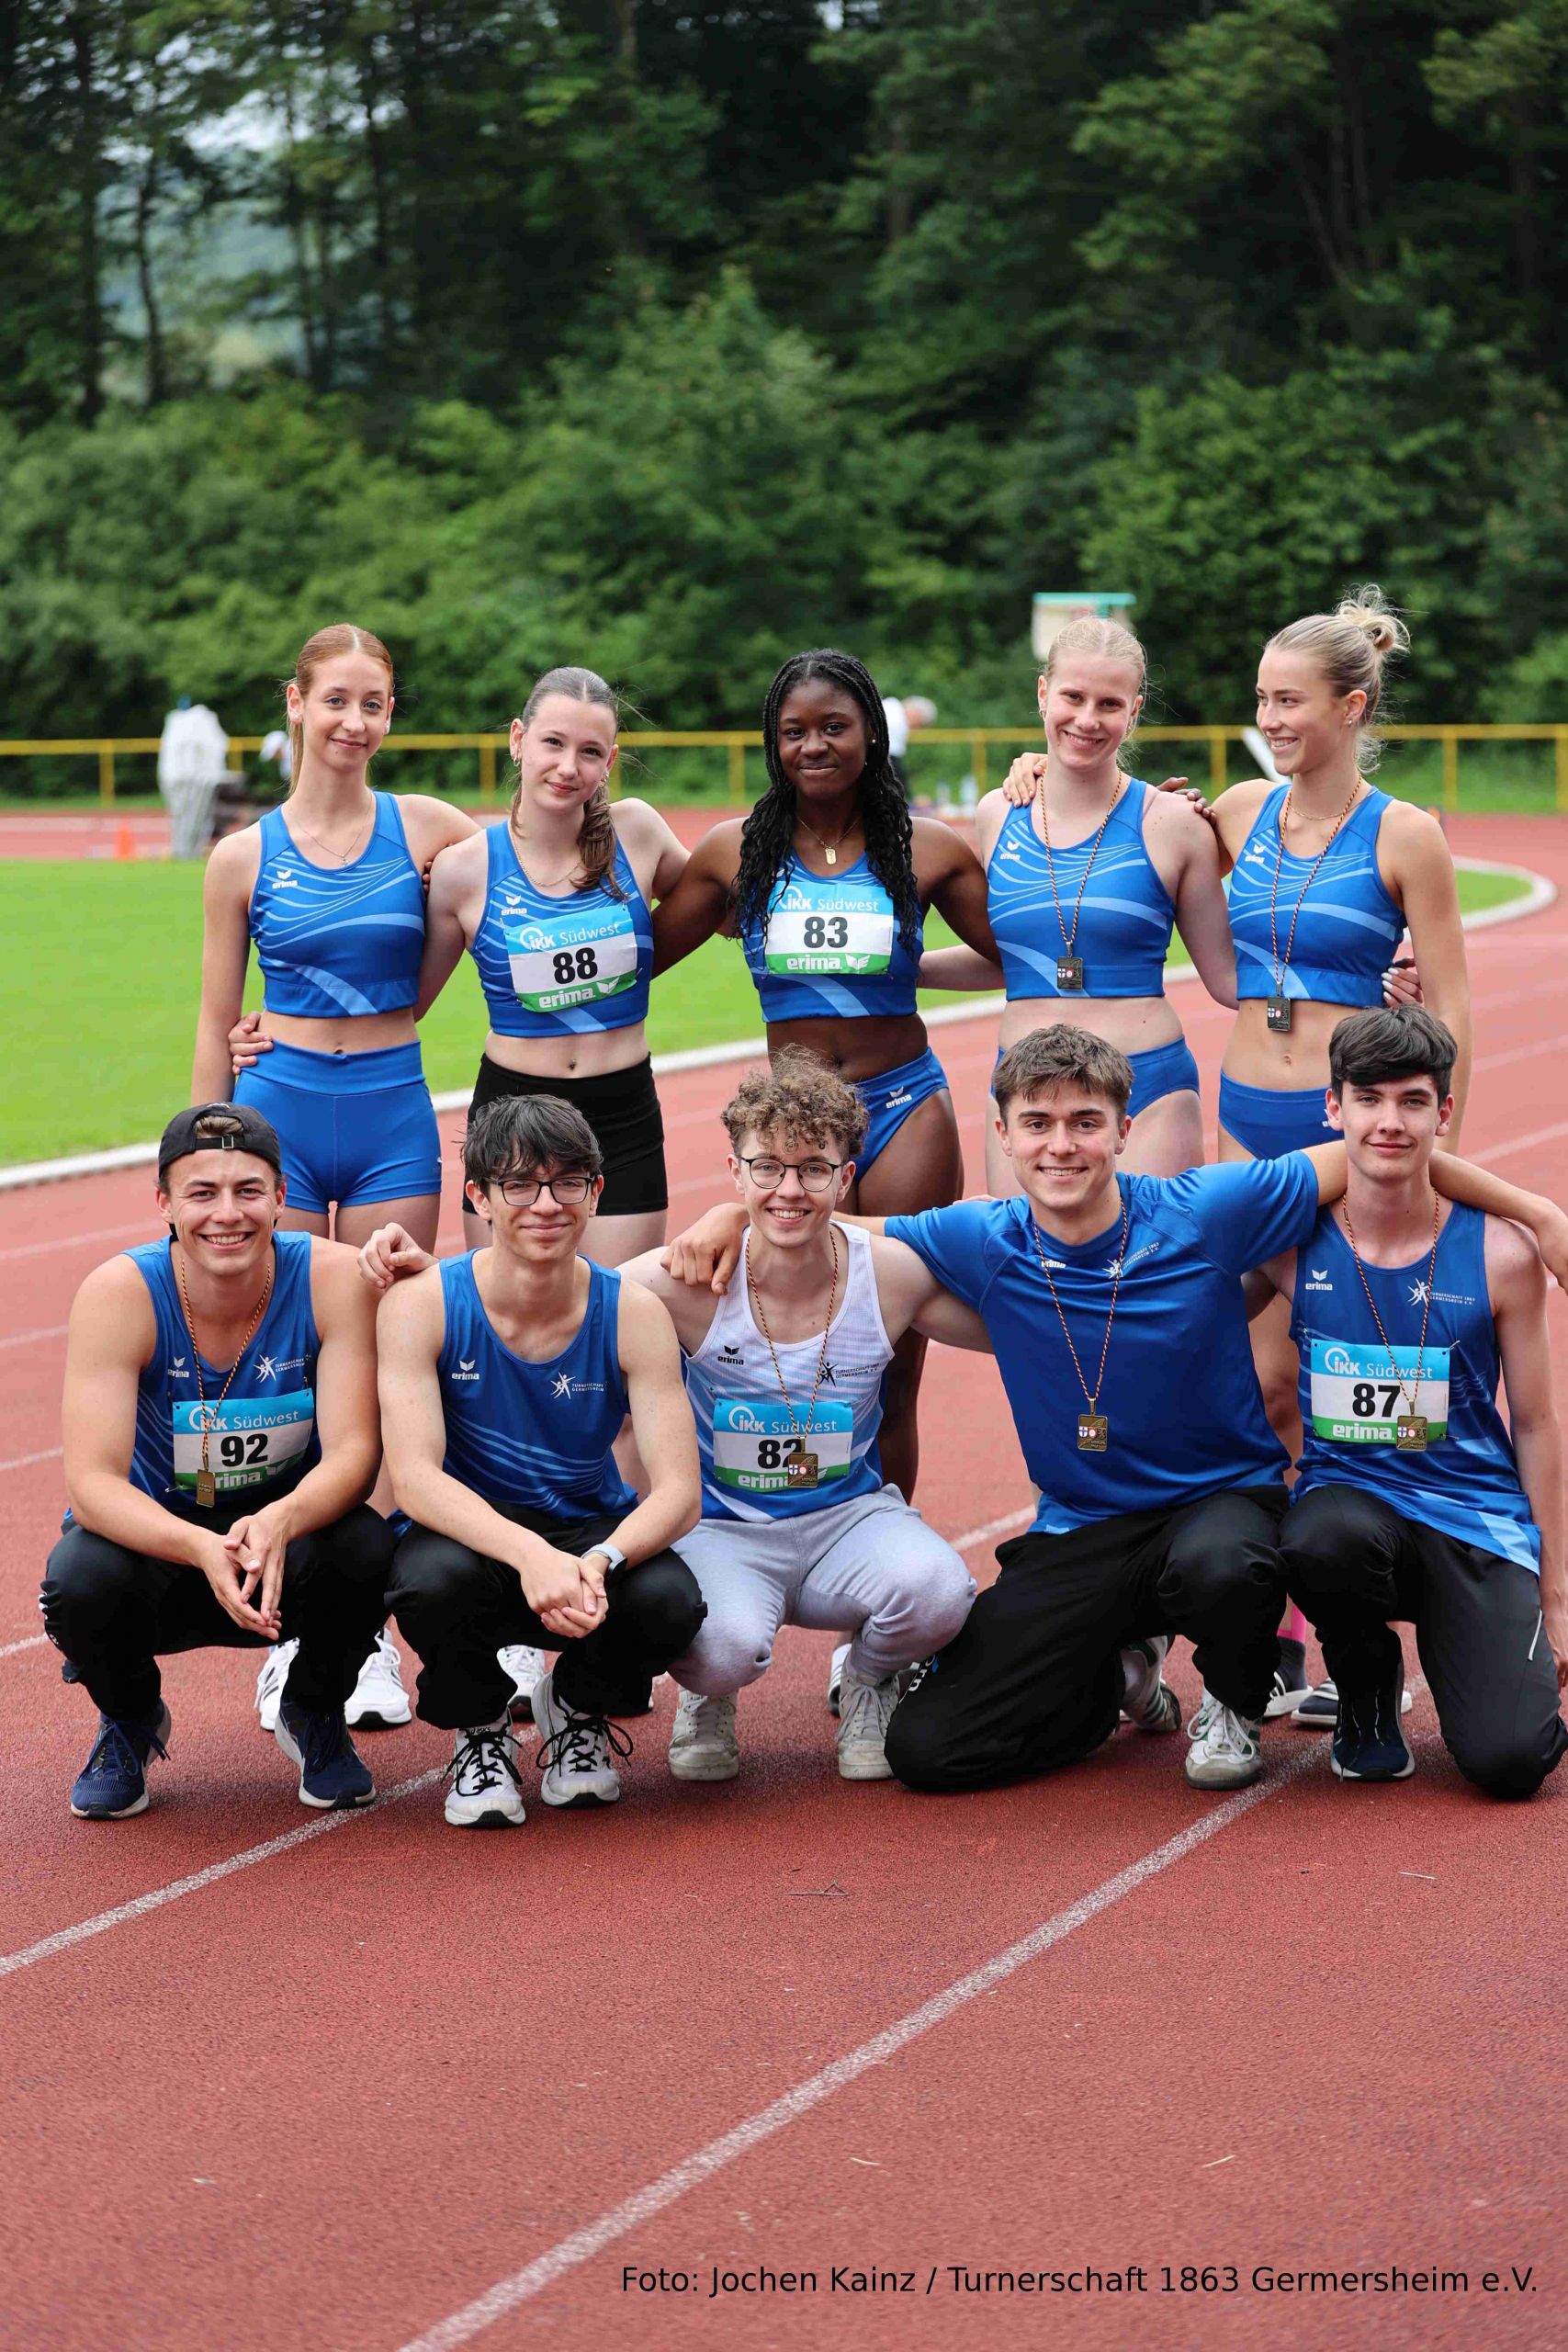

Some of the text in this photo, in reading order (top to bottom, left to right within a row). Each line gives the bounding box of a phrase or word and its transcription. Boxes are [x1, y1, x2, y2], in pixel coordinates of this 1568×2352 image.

[501, 905, 528, 916] erima
[818, 898, 879, 911] Südwest
[559, 922, 621, 944] Südwest
[804, 916, 848, 949] 83
[552, 946, 598, 985] 88
[886, 1093, 913, 1109] erima
[1305, 1282, 1333, 1291] erima
[717, 1355, 745, 1365] erima
[451, 1373, 480, 1381] erima
[1366, 1363, 1433, 1378] Südwest
[1352, 1383, 1401, 1418] 87
[233, 1410, 299, 1430] Südwest
[771, 1419, 837, 1434] Südwest
[220, 1433, 268, 1467] 92
[215, 1471, 261, 1489] rima
